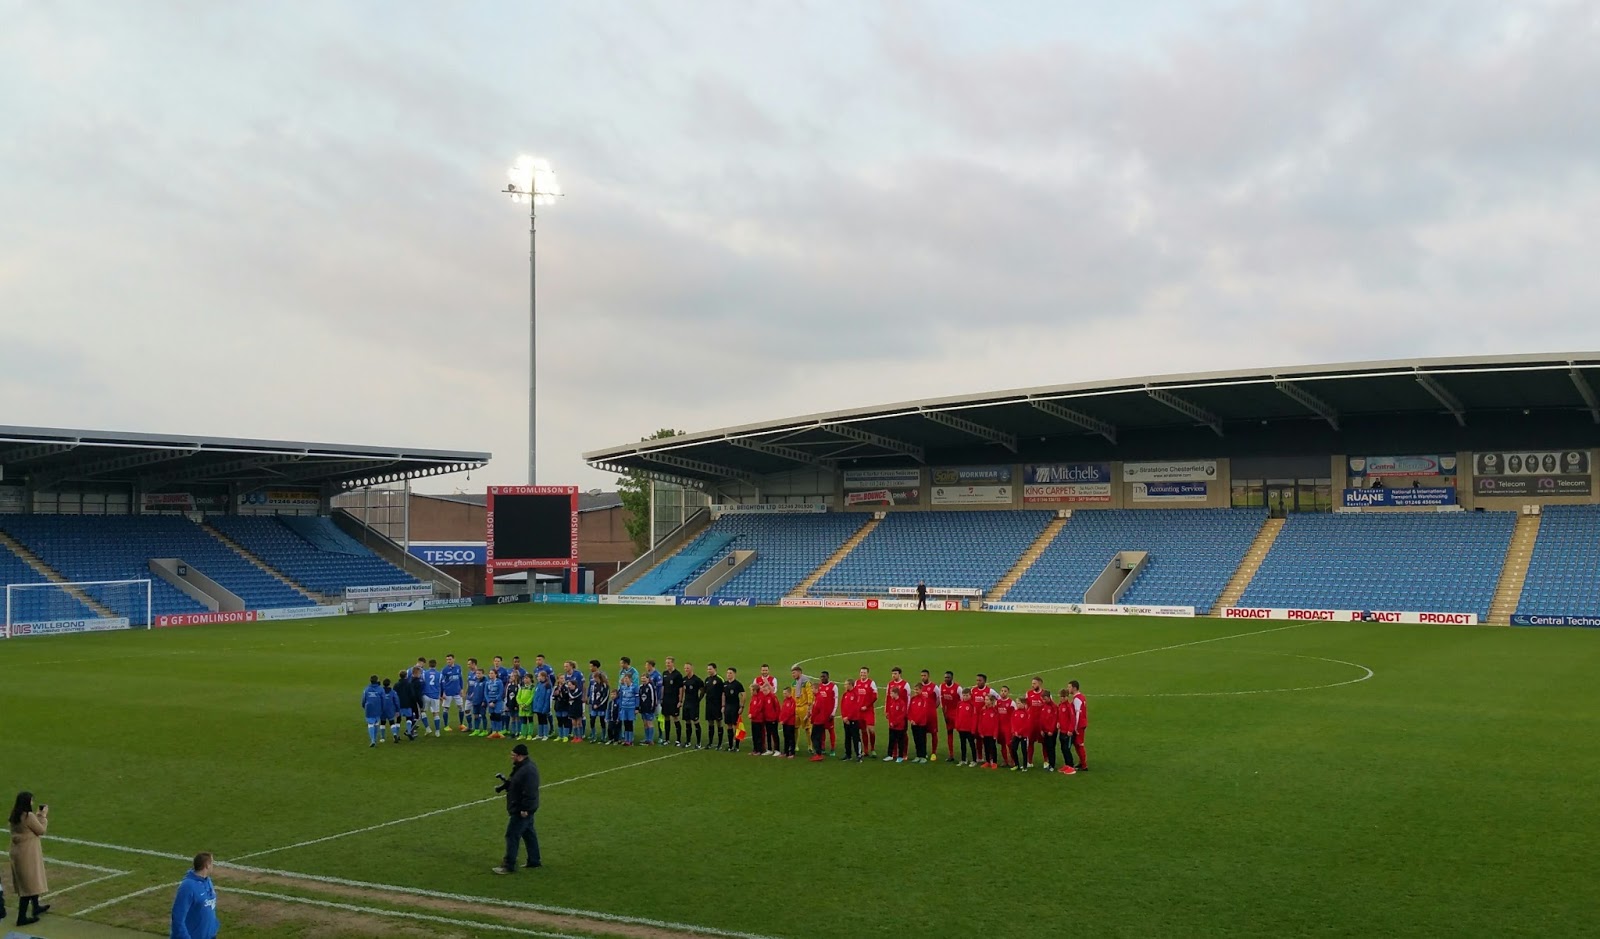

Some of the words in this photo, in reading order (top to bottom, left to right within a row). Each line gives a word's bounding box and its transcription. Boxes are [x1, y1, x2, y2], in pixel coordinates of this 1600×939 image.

[1051, 466, 1099, 480] Mitchells
[864, 491, 887, 500] BOUNCE
[1025, 486, 1044, 495] KING
[1045, 486, 1076, 495] CARPETS
[1346, 491, 1384, 504] RUANE
[423, 550, 476, 562] TESCO
[487, 563, 493, 573] GF
[495, 560, 570, 568] www.gftomlinson.co.uk
[571, 562, 578, 573] GF
[498, 594, 519, 604] CARLING
[697, 597, 712, 605] Child
[736, 598, 751, 606] Child
[1226, 608, 1271, 618] PROACT
[1287, 610, 1335, 620] PROACT
[171, 616, 183, 625] GF
[186, 612, 243, 624] TOMLINSON
[1419, 613, 1471, 624] PROACT
[1530, 615, 1564, 625] Central
[1566, 616, 1600, 626] Techno
[32, 620, 85, 630] WILLBOND
[429, 674, 435, 686] 2
